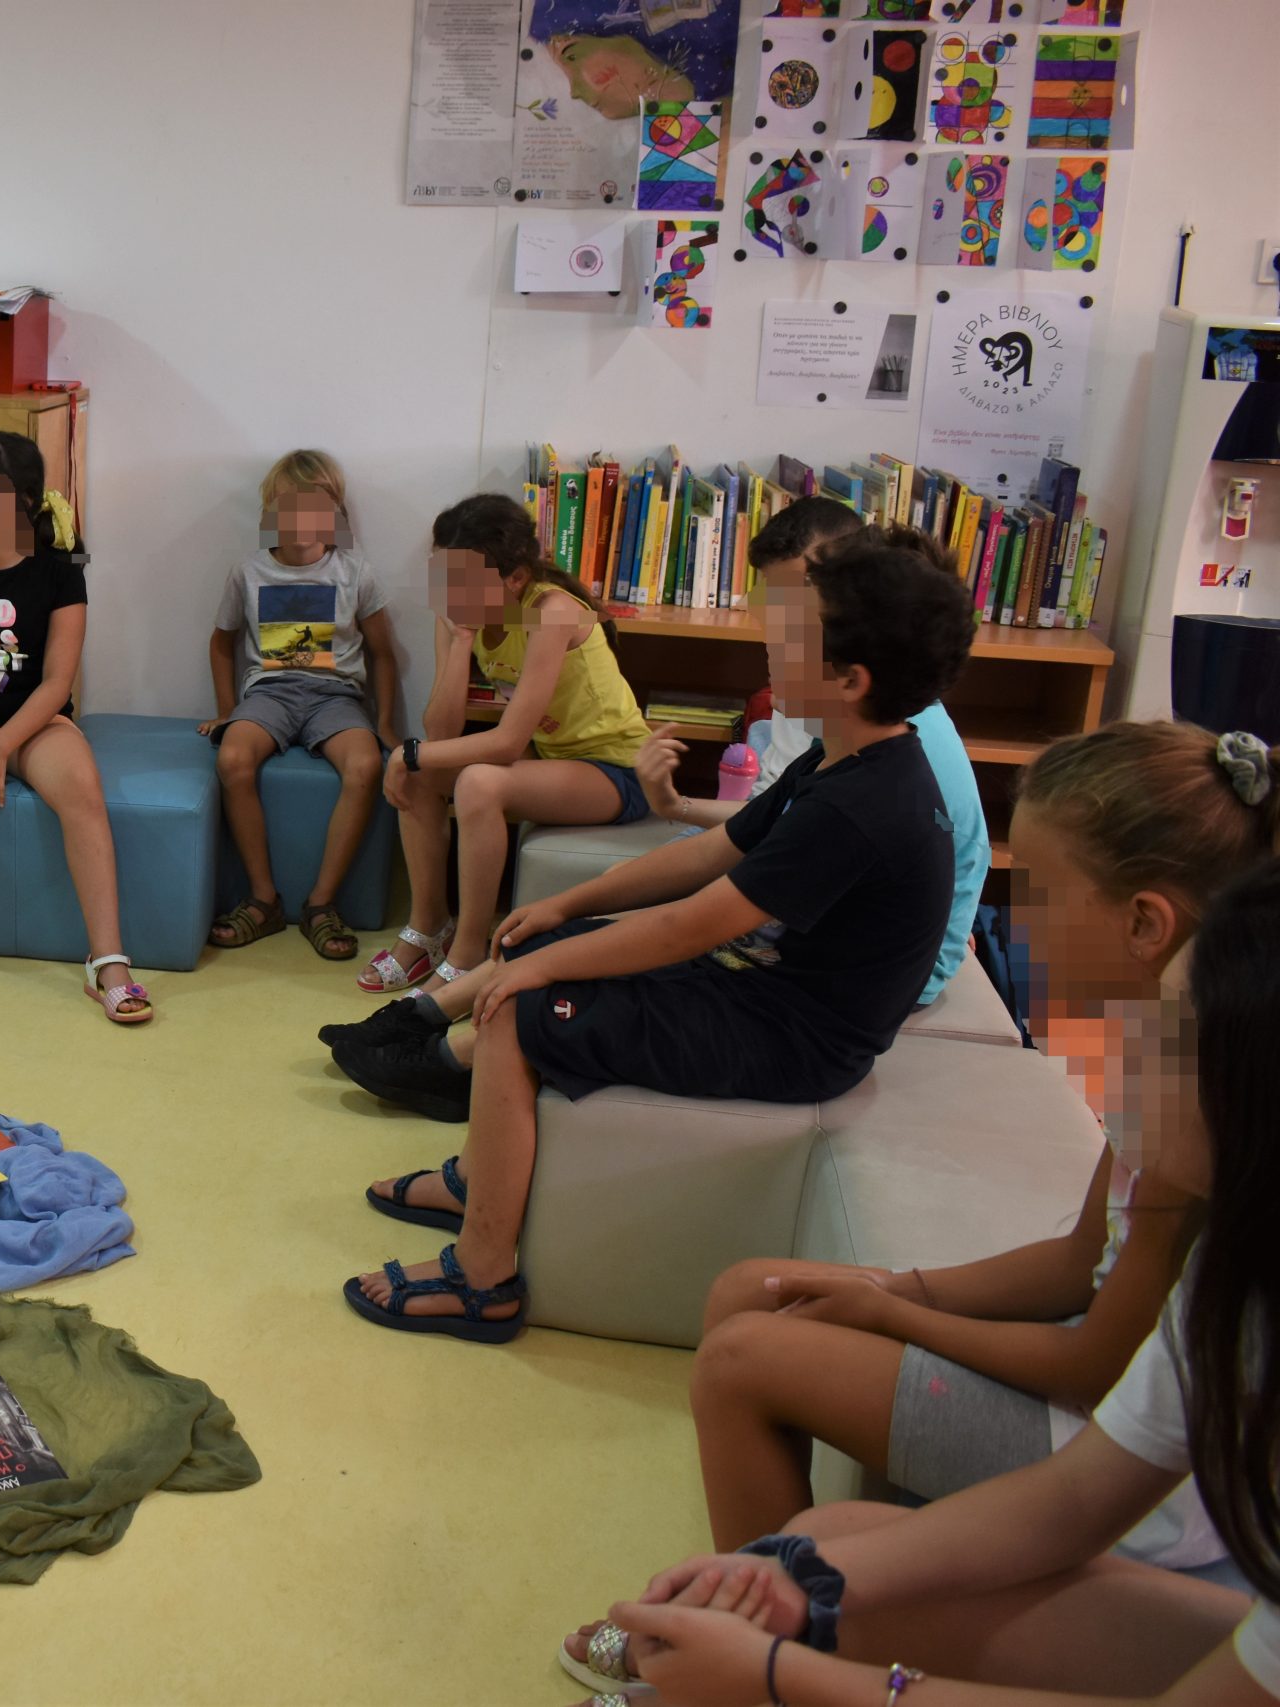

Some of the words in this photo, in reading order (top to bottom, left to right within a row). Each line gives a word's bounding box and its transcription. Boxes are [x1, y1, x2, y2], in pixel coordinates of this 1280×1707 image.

[952, 313, 992, 376] ΗΜΕΡΑ
[1000, 305, 1063, 350] ΒΙΒΛΙΟΥ
[959, 386, 1009, 414] ΔΙΑΒΑΖΩ
[1030, 362, 1063, 407] ΑΛΛΑΖΩ
[983, 380, 1018, 394] 2023
